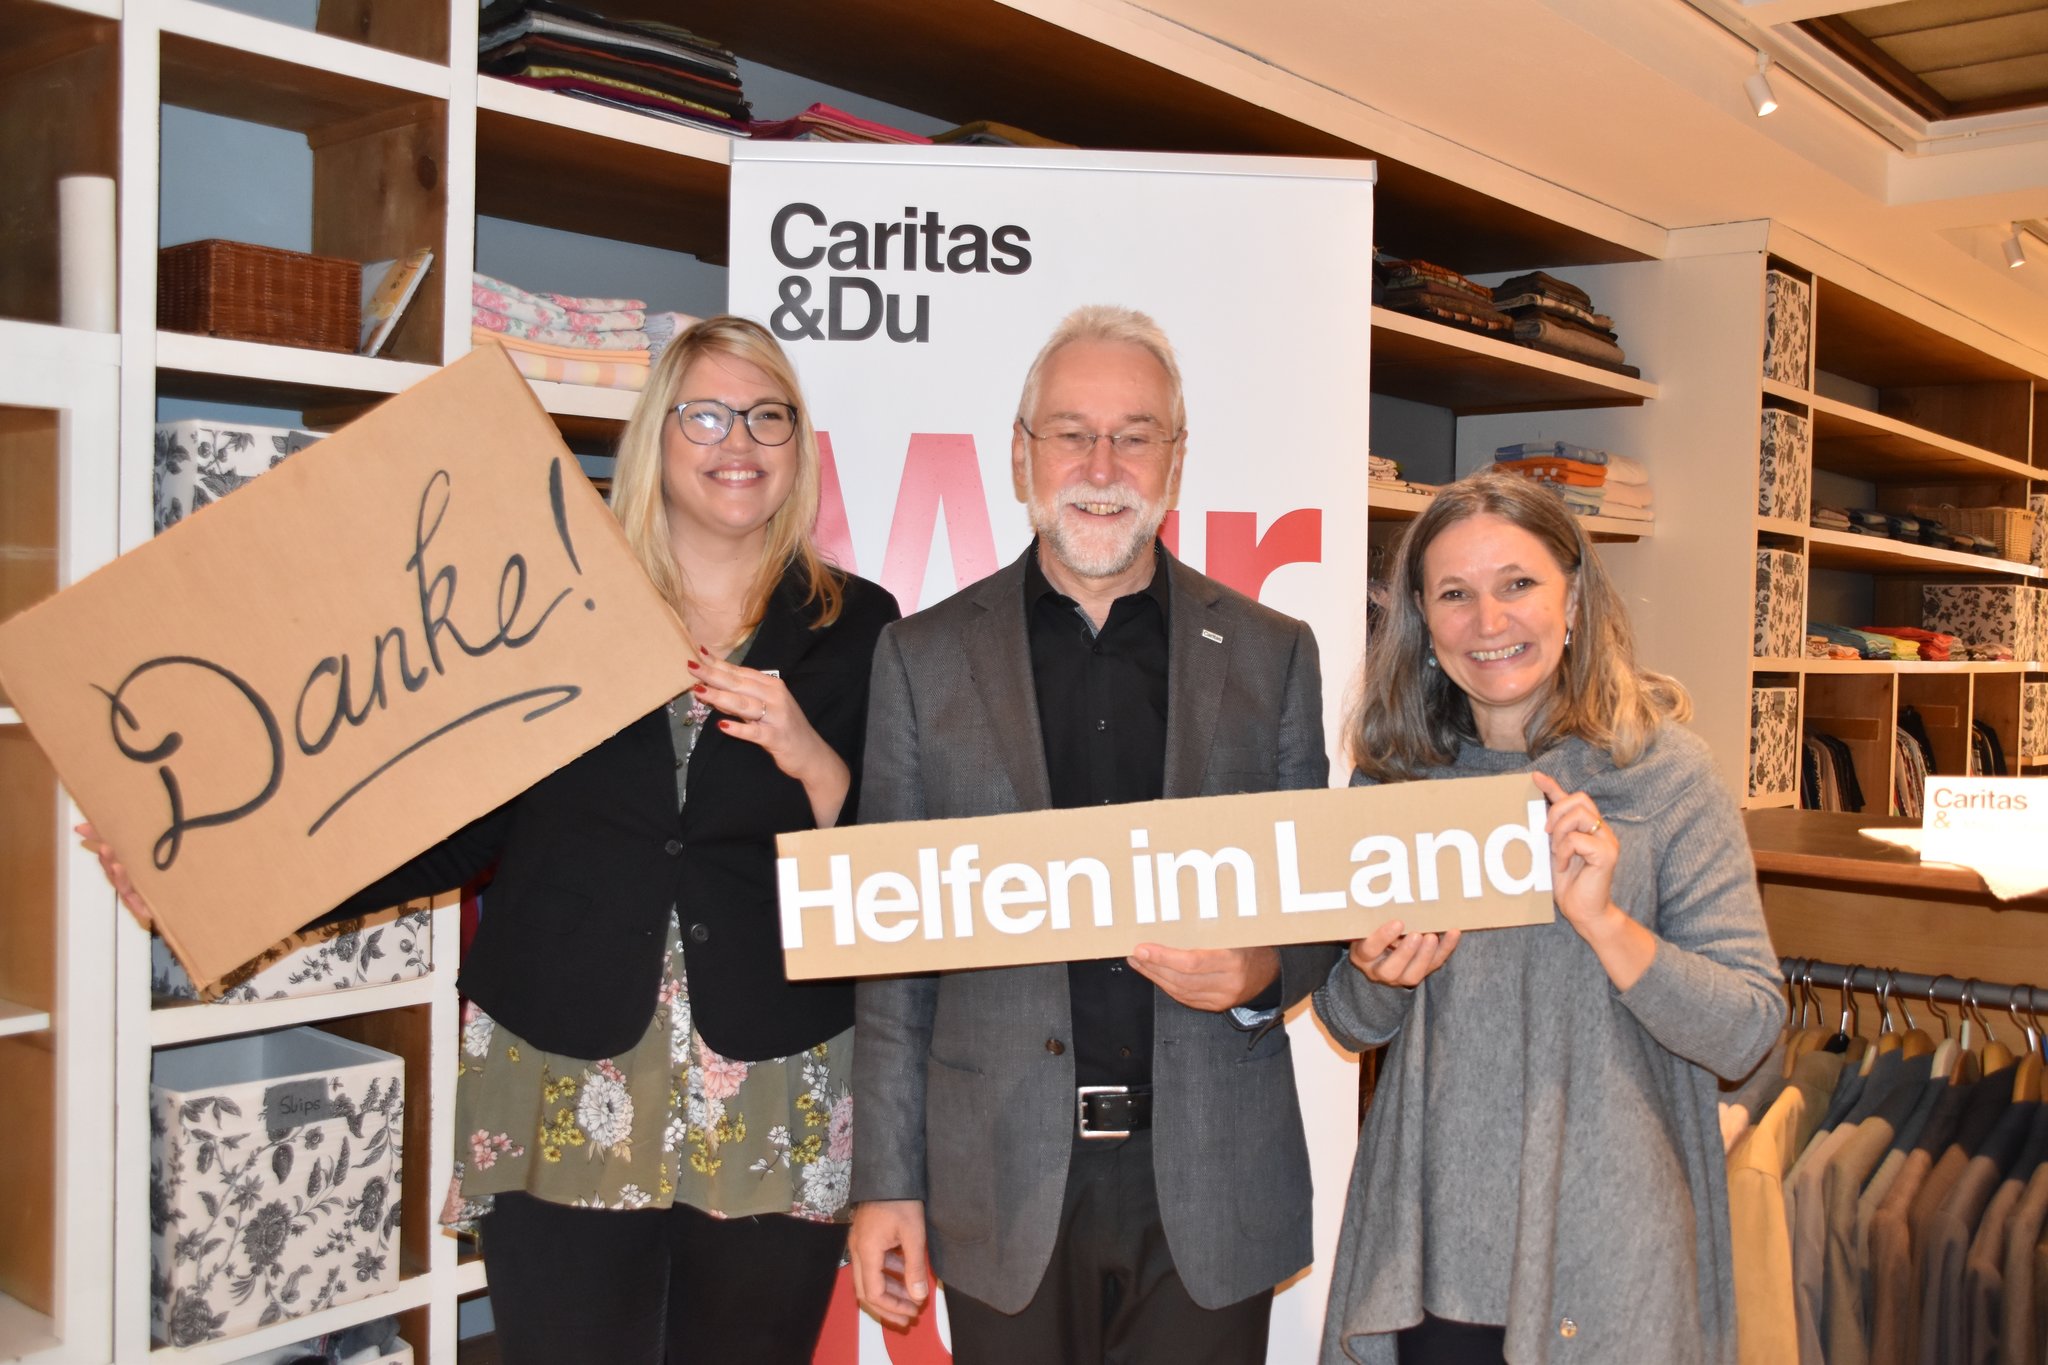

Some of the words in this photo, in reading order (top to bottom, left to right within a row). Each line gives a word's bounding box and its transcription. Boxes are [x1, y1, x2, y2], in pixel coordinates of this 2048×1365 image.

[770, 202, 1032, 275] Caritas
[769, 276, 930, 343] &Du
[90, 457, 595, 871] Danke!
[1933, 787, 2028, 810] Caritas
[777, 843, 1113, 949] Helfen
[1131, 829, 1257, 924] im
[1275, 800, 1555, 913] Land
